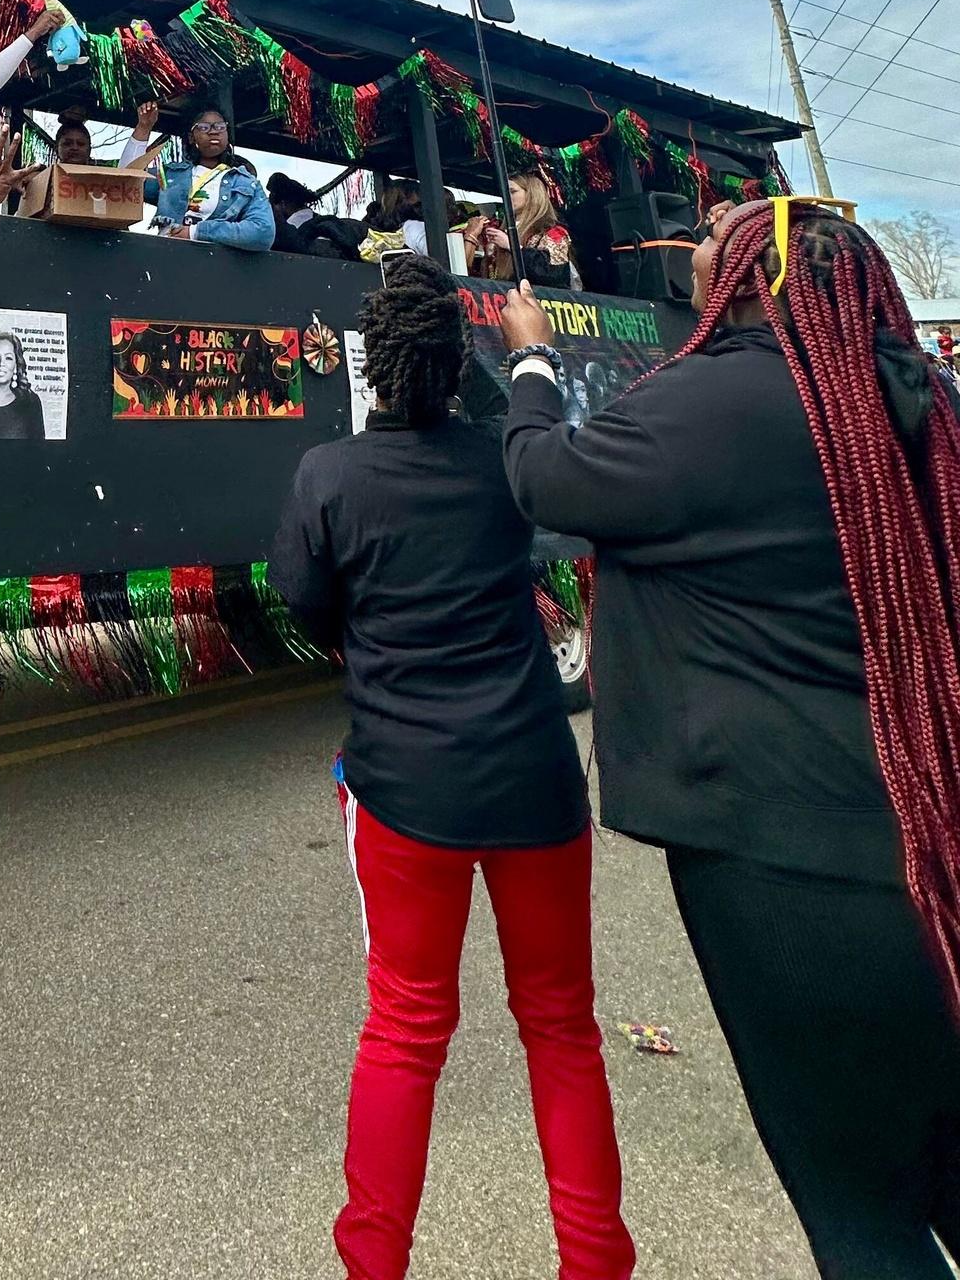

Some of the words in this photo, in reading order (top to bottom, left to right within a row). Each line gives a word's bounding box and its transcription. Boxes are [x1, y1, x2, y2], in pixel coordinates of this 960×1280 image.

[601, 307, 660, 344] MONTH
[188, 329, 235, 349] BLACK
[180, 350, 246, 374] HISTORY
[194, 376, 229, 388] MONTH
